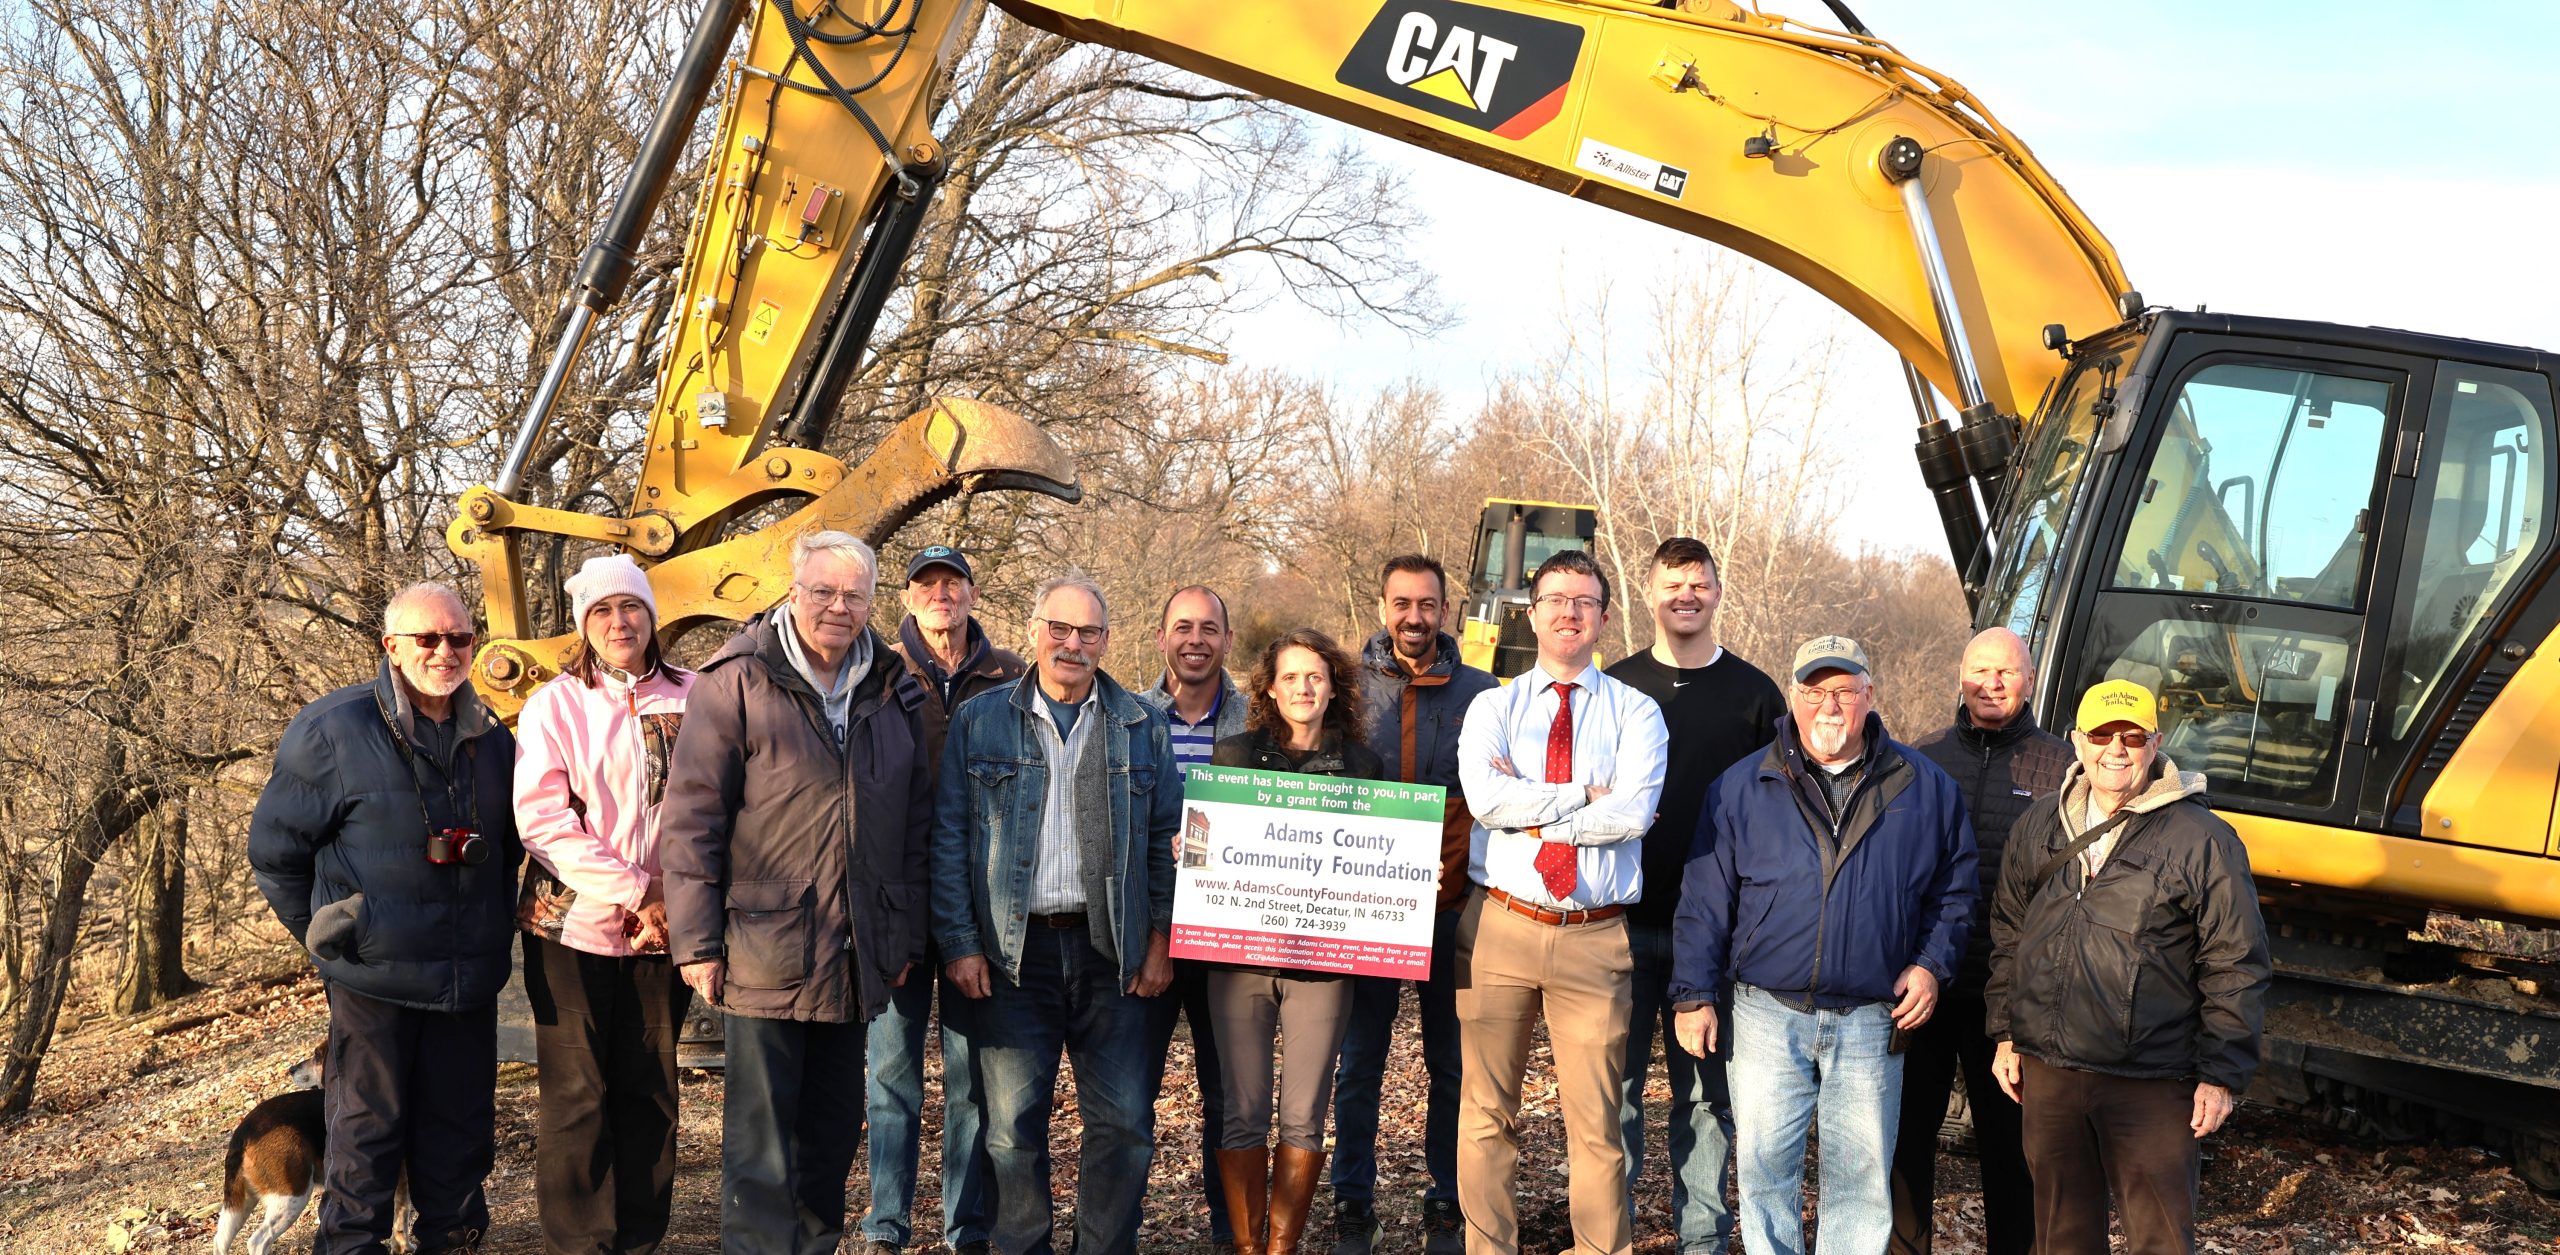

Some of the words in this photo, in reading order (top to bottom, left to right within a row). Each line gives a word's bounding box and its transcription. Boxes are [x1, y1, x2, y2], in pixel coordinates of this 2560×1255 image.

[1386, 12, 1518, 113] CAT
[1598, 158, 1651, 180] MacAllister
[1658, 172, 1684, 191] CAT
[2100, 692, 2118, 701] South
[2119, 692, 2138, 701] Adams
[1192, 769, 1213, 781] This
[1218, 774, 1248, 784] event
[1253, 774, 1272, 786] has
[1276, 776, 1304, 789] been
[1308, 780, 1353, 796] brought
[1358, 786, 1369, 795] to
[1373, 788, 1396, 799] you,
[1400, 788, 1410, 799] in
[1414, 791, 1440, 803] part,
[1258, 790, 1271, 804] by
[1276, 795, 1282, 803] a
[1287, 796, 1317, 806] grant
[1322, 796, 1347, 808] from
[1353, 799, 1370, 811] the
[1264, 822, 1322, 844] Adams
[1333, 828, 1395, 856] County
[1222, 846, 1322, 877] Community
[1332, 856, 1432, 882] Foundation
[1195, 879, 1229, 890] www.
[1234, 880, 1417, 910] AdamsCountyFoundation.org
[1206, 894, 1224, 905] 102
[1230, 896, 1241, 907] N.
[1244, 898, 1265, 909] 2nd
[1268, 900, 1303, 914] Street,
[1306, 903, 1350, 918] Decatur,
[1354, 908, 1366, 918] IN
[1371, 910, 1404, 921] 46733
[1261, 914, 1288, 928] (260)
[1296, 918, 1346, 931] 724-3939
[1184, 939, 1219, 948] scholarship,
[1265, 945, 1276, 953] this
[1278, 947, 1314, 956] information
[1246, 935, 1276, 943] contribute
[1319, 942, 1340, 950] County
[1363, 945, 1384, 953] benefit
[1245, 953, 1353, 970] ACCF@AdamsCountyFoundation.org
